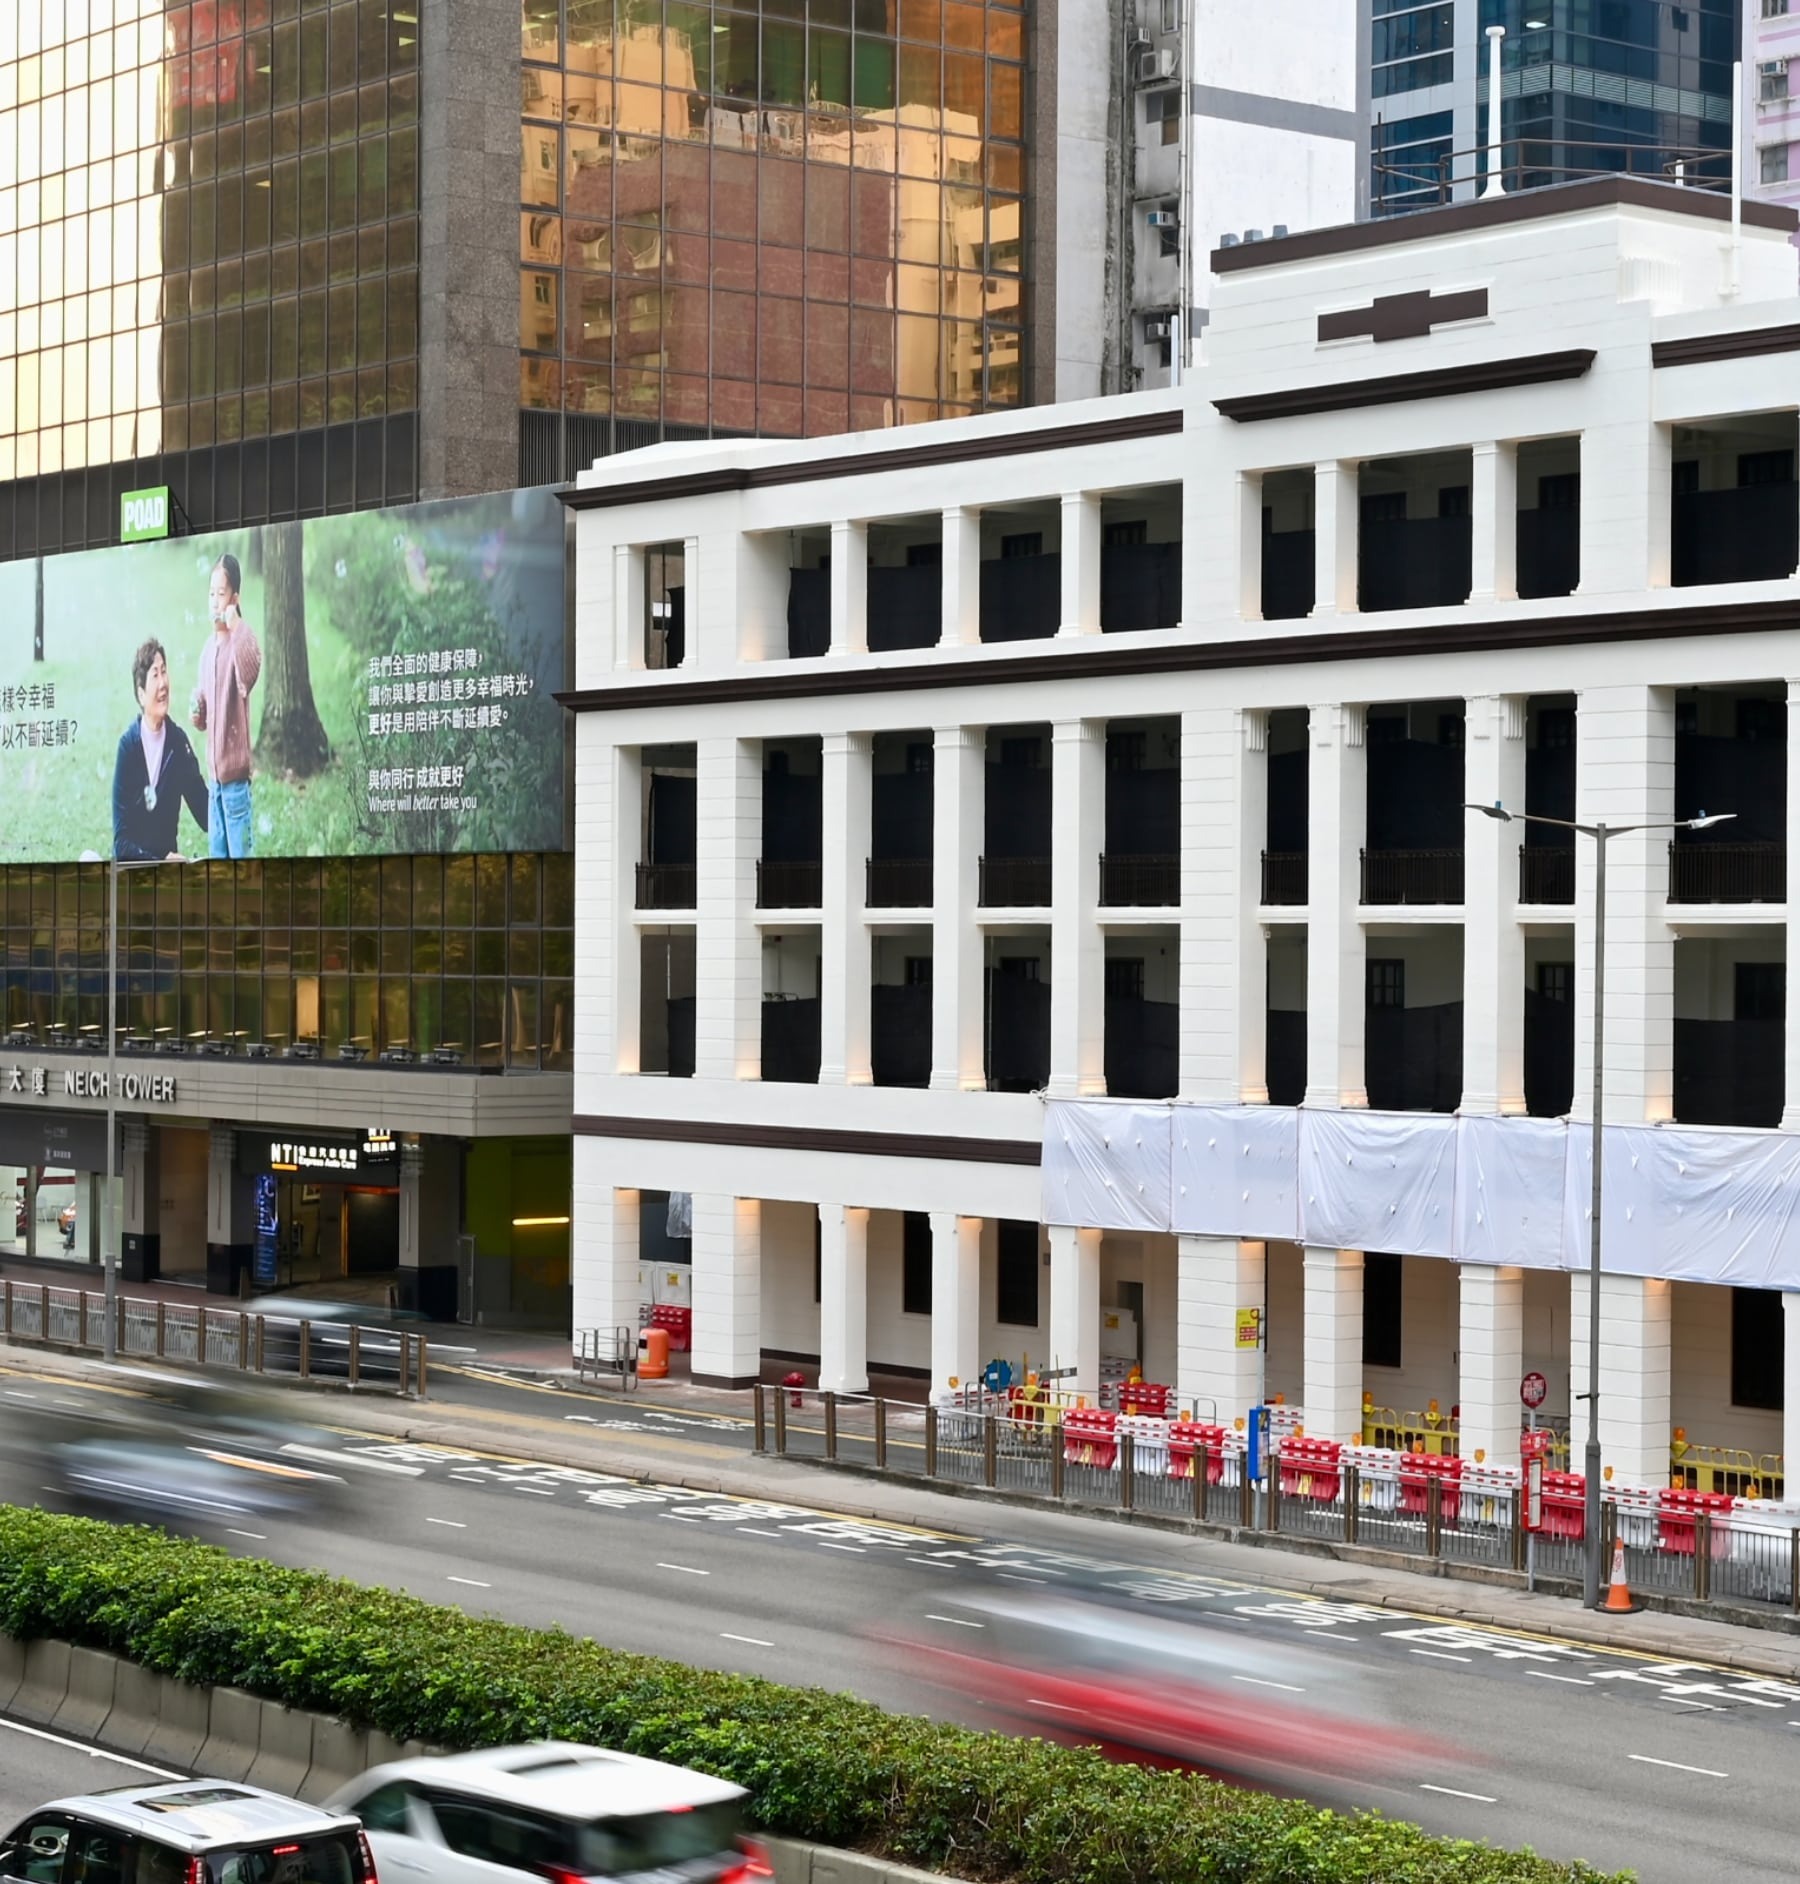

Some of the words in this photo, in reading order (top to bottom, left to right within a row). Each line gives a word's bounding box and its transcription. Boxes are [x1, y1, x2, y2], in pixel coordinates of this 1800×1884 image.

[124, 496, 164, 532] POAD
[0, 683, 55, 712] 樣令幸福
[0, 719, 78, 749] 以不斷延續？
[369, 768, 415, 791] 與你同行
[416, 766, 464, 788] 成就更好
[369, 796, 400, 812] Where
[398, 796, 411, 811] will
[413, 794, 440, 811] better
[440, 794, 459, 810] take
[461, 796, 477, 813] you
[65, 1070, 110, 1097] NEICH
[117, 1073, 175, 1102] TOWER
[271, 1143, 298, 1164] NTI
[1234, 1600, 1411, 1626] BUS
[1380, 1626, 1597, 1662] 站
